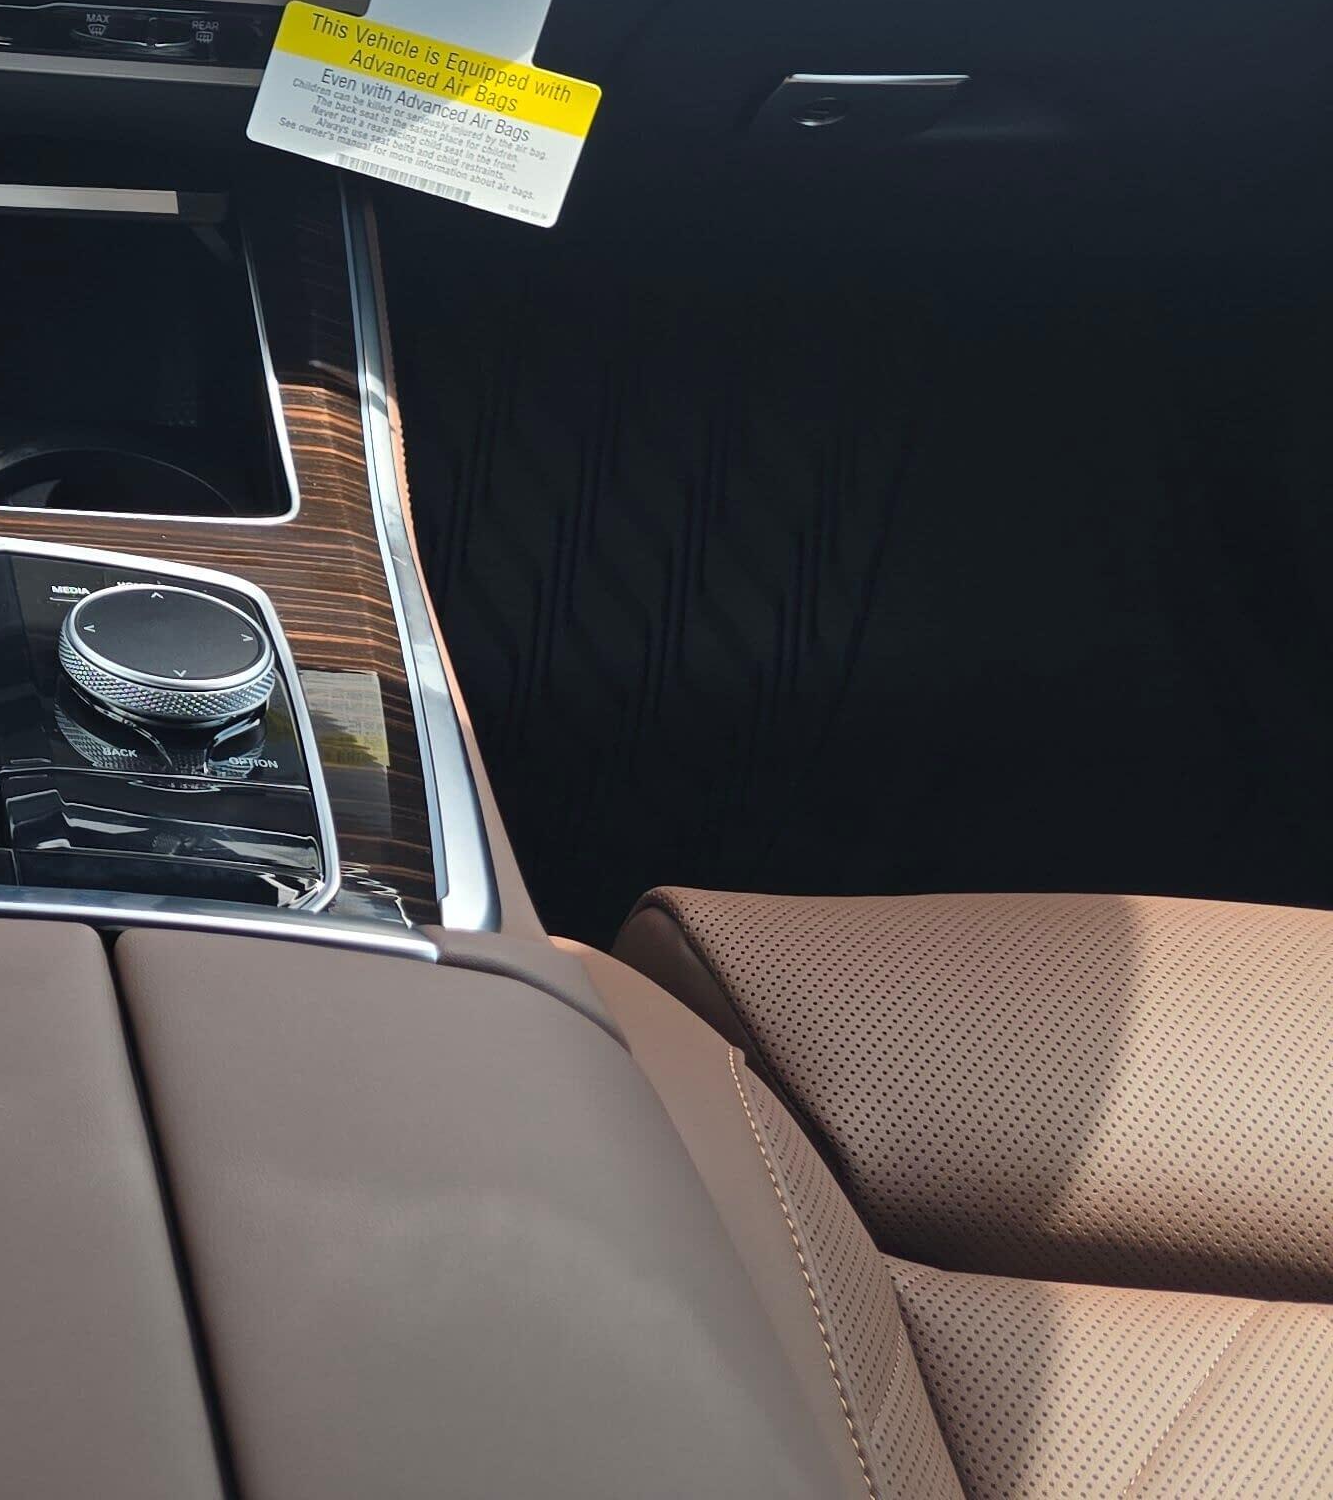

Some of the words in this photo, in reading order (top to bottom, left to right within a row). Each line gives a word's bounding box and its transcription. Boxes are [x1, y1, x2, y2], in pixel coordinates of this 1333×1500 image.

[86, 14, 110, 23] MAX
[191, 20, 219, 31] REAR
[313, 13, 348, 39] This
[356, 25, 419, 59] Vehicle
[425, 46, 440, 65] is
[445, 52, 530, 91] Equipped
[534, 80, 571, 104] with
[349, 49, 439, 88] Advanced
[442, 76, 471, 97] Air
[475, 84, 518, 112] Bags
[292, 78, 332, 97] Children
[333, 91, 351, 102] can
[352, 94, 365, 106] be
[366, 98, 392, 114] killed
[394, 107, 405, 118] or
[406, 111, 449, 132] seriously
[485, 134, 498, 146] by
[498, 138, 513, 150] the
[516, 143, 528, 153] air
[316, 95, 332, 108] The
[335, 102, 358, 115] back
[359, 108, 380, 121] seat
[382, 113, 390, 125] is
[391, 117, 407, 130] the
[409, 124, 438, 140] safest
[439, 131, 464, 147] place
[465, 139, 480, 150] for
[321, 68, 356, 91] Even
[361, 82, 392, 101] with
[394, 90, 468, 123] Advanced
[469, 112, 493, 131] Air
[494, 118, 531, 142] Bags
[278, 117, 296, 130] See
[298, 125, 335, 141] owner's
[336, 135, 372, 151] manual
[373, 144, 387, 157] for
[388, 151, 414, 165] more
[415, 157, 468, 180] information
[469, 173, 496, 189] about
[497, 181, 510, 192] air
[311, 105, 338, 121] Never
[340, 115, 357, 128] put
[358, 121, 366, 129] a
[418, 138, 442, 153] child
[444, 144, 463, 158] seat
[465, 148, 475, 160] in
[476, 153, 491, 166] the
[316, 117, 349, 135] Always
[351, 128, 369, 140] use
[370, 134, 391, 147] seat
[391, 140, 415, 155] belts
[416, 148, 434, 161] and
[436, 152, 459, 167] child
[51, 585, 90, 596] MEDIA
[102, 747, 137, 758] BACK
[228, 756, 278, 769] OPTION
